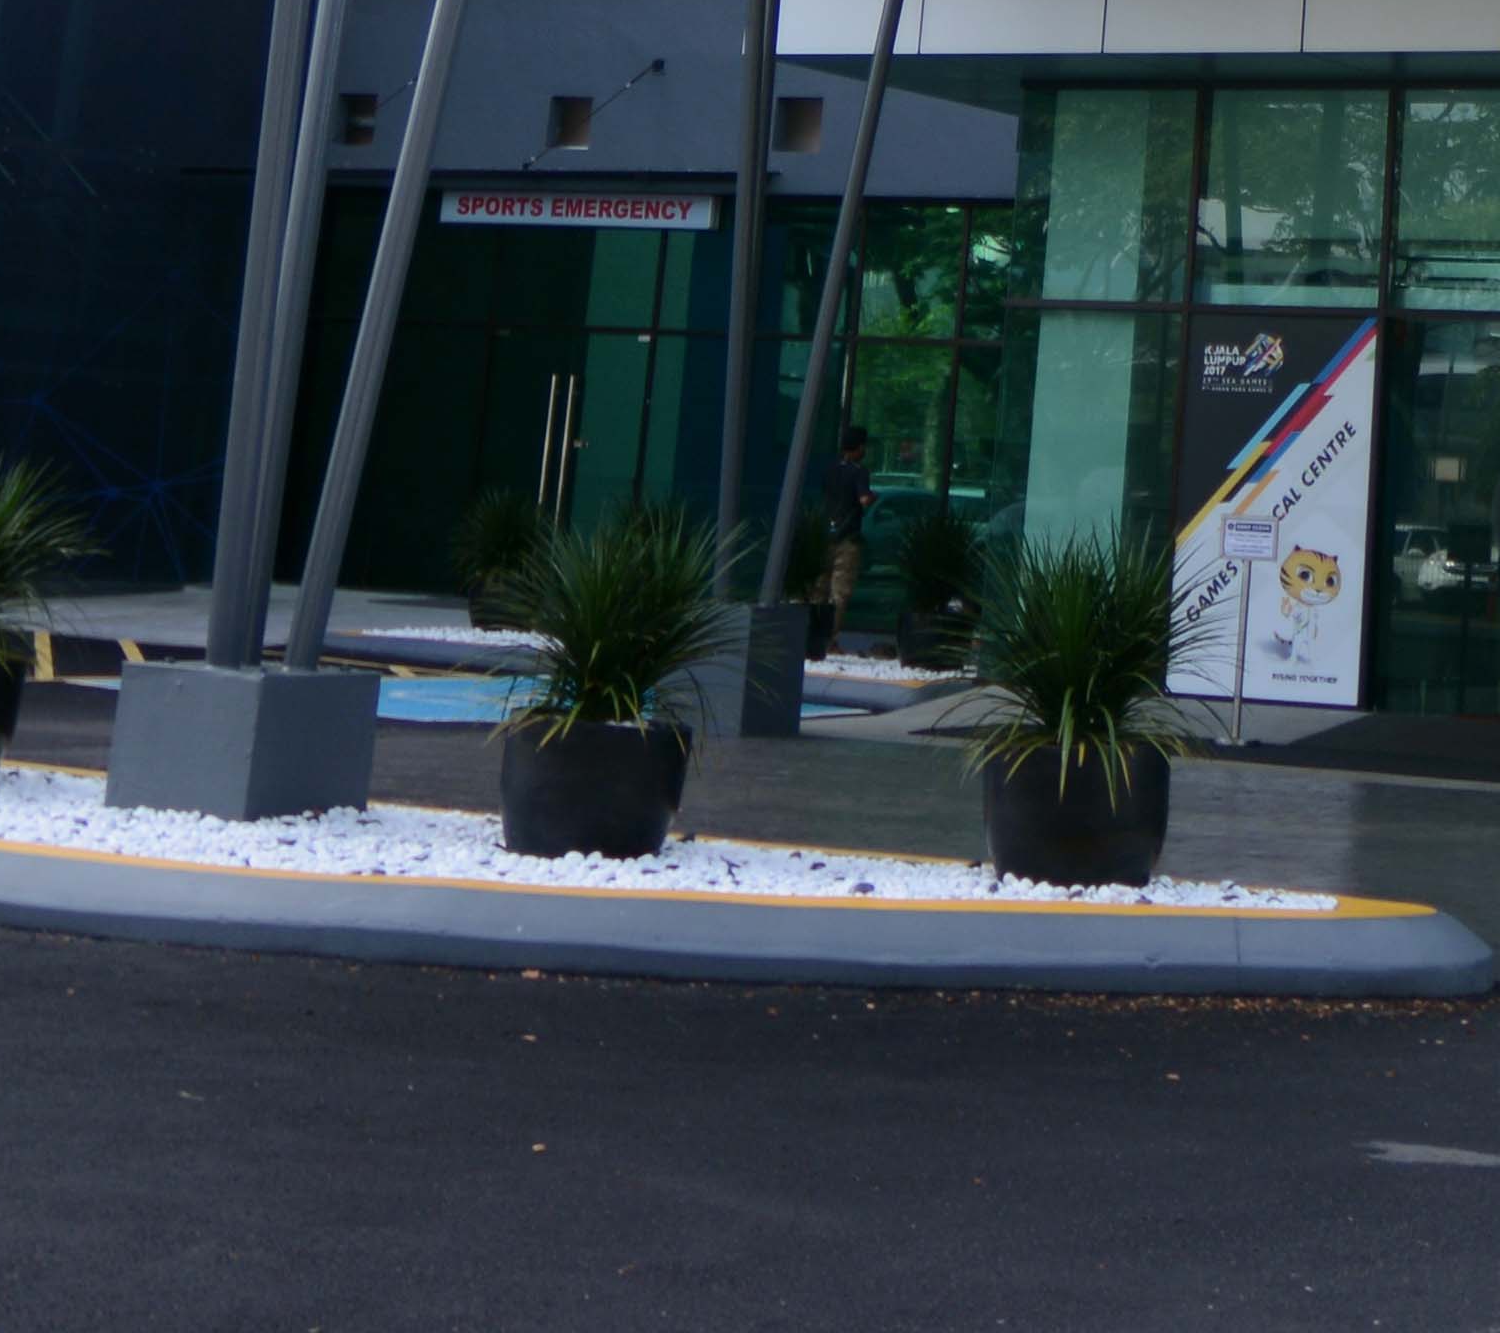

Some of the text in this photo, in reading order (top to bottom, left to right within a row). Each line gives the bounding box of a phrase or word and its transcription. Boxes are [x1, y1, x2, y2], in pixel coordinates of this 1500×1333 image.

[457, 196, 693, 221] SPORTS EMERGENCY
[1203, 365, 1226, 376] 2017
[1185, 420, 1357, 623] GAMES CENTRE
